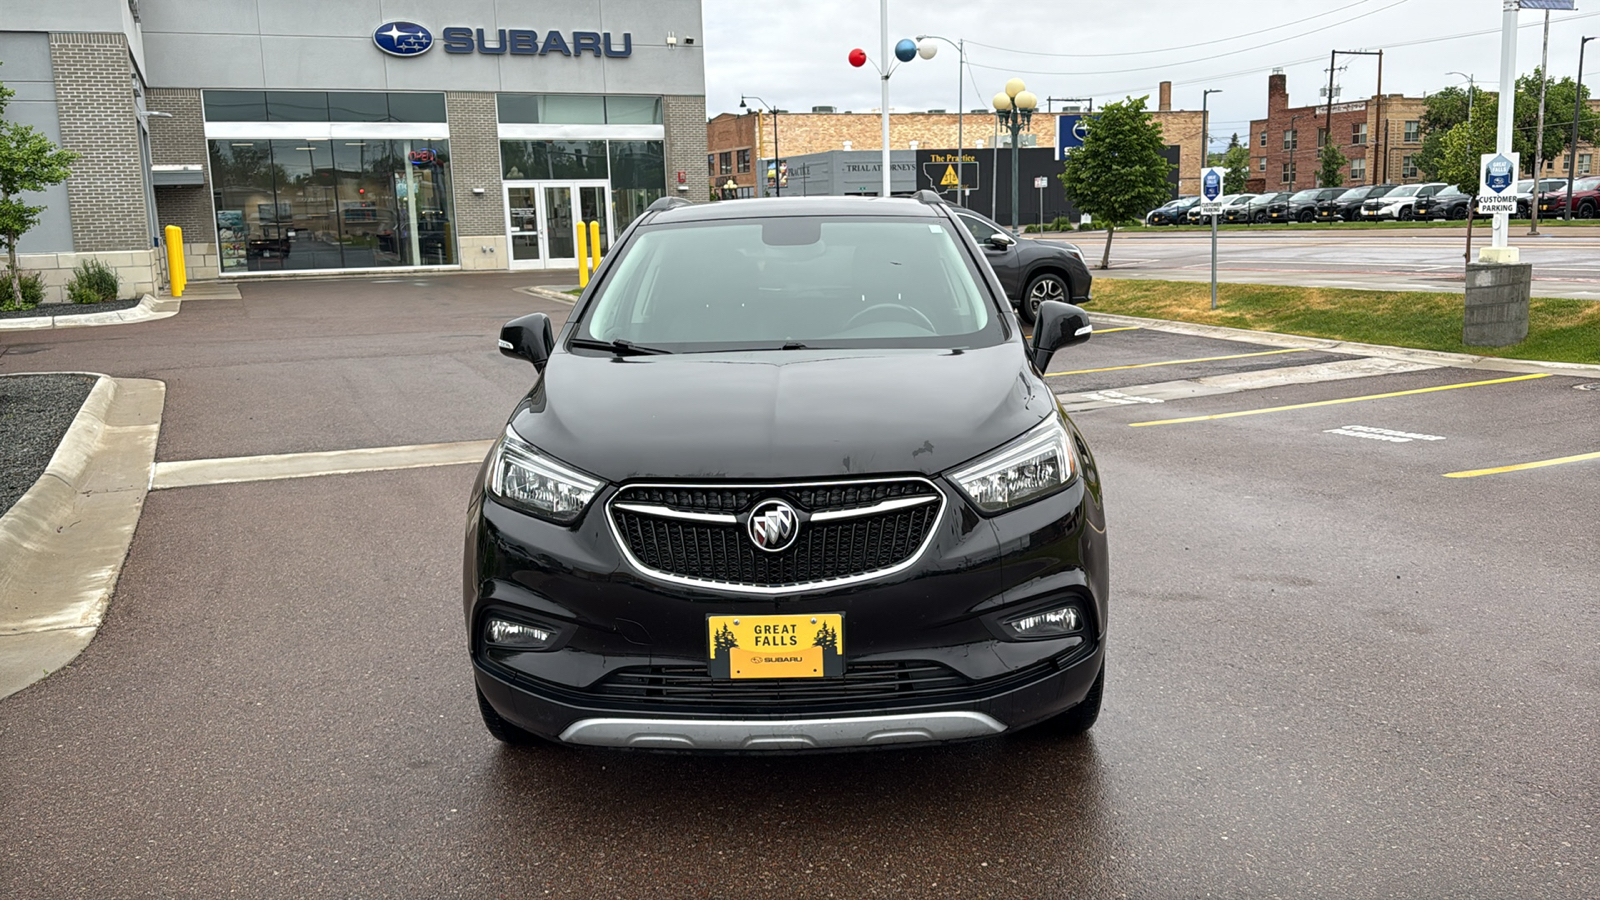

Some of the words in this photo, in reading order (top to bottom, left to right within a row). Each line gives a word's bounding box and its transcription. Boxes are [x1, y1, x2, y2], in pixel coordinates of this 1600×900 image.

[442, 27, 632, 58] SUBARU
[930, 154, 944, 162] The
[946, 154, 975, 162] Pratice
[846, 164, 870, 172] TRIAL
[872, 163, 916, 172] ATRNEYS
[754, 625, 797, 634] GREAT
[755, 636, 797, 646] FALLS
